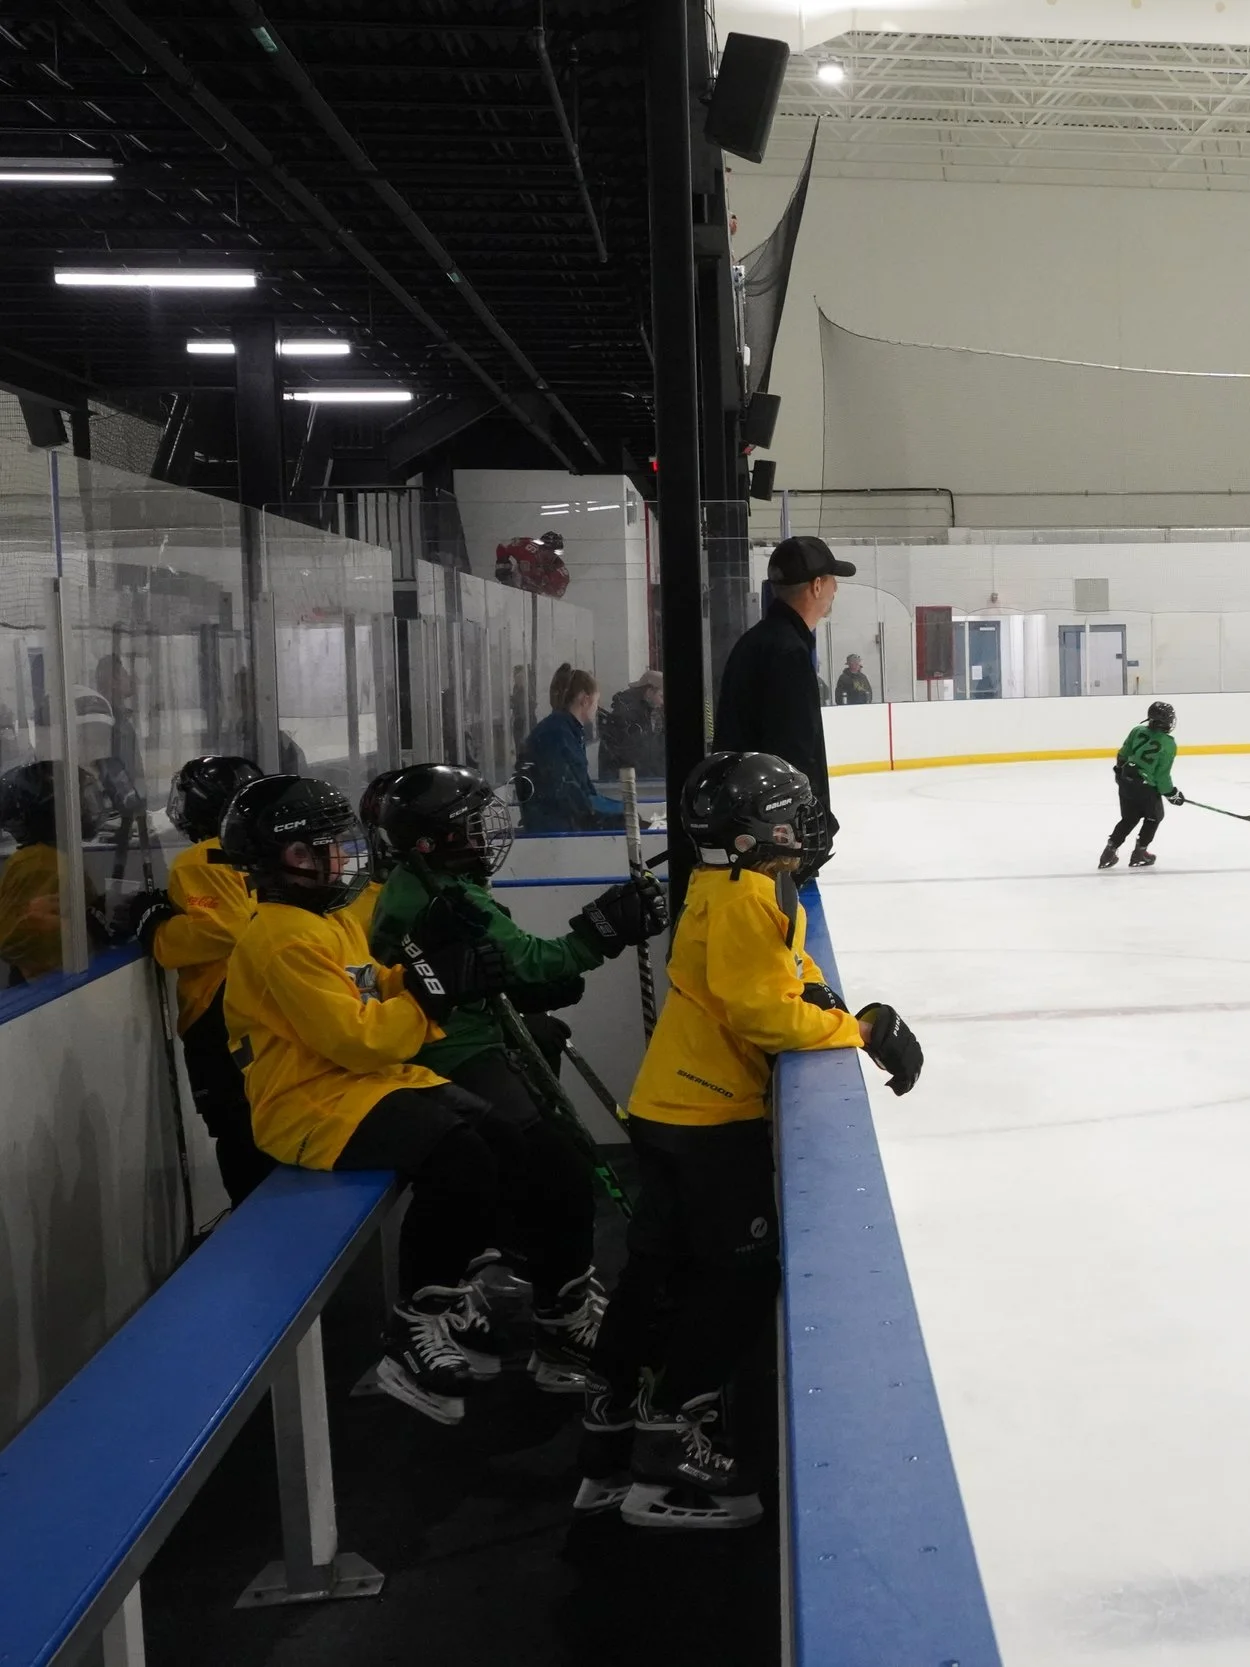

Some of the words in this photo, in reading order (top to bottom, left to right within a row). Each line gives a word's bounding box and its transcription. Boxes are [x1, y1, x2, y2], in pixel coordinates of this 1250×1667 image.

[1132, 732, 1162, 765] 72
[765, 798, 793, 812] BAUER
[273, 819, 306, 833] CCM
[676, 1068, 735, 1099] SHERWOOD
